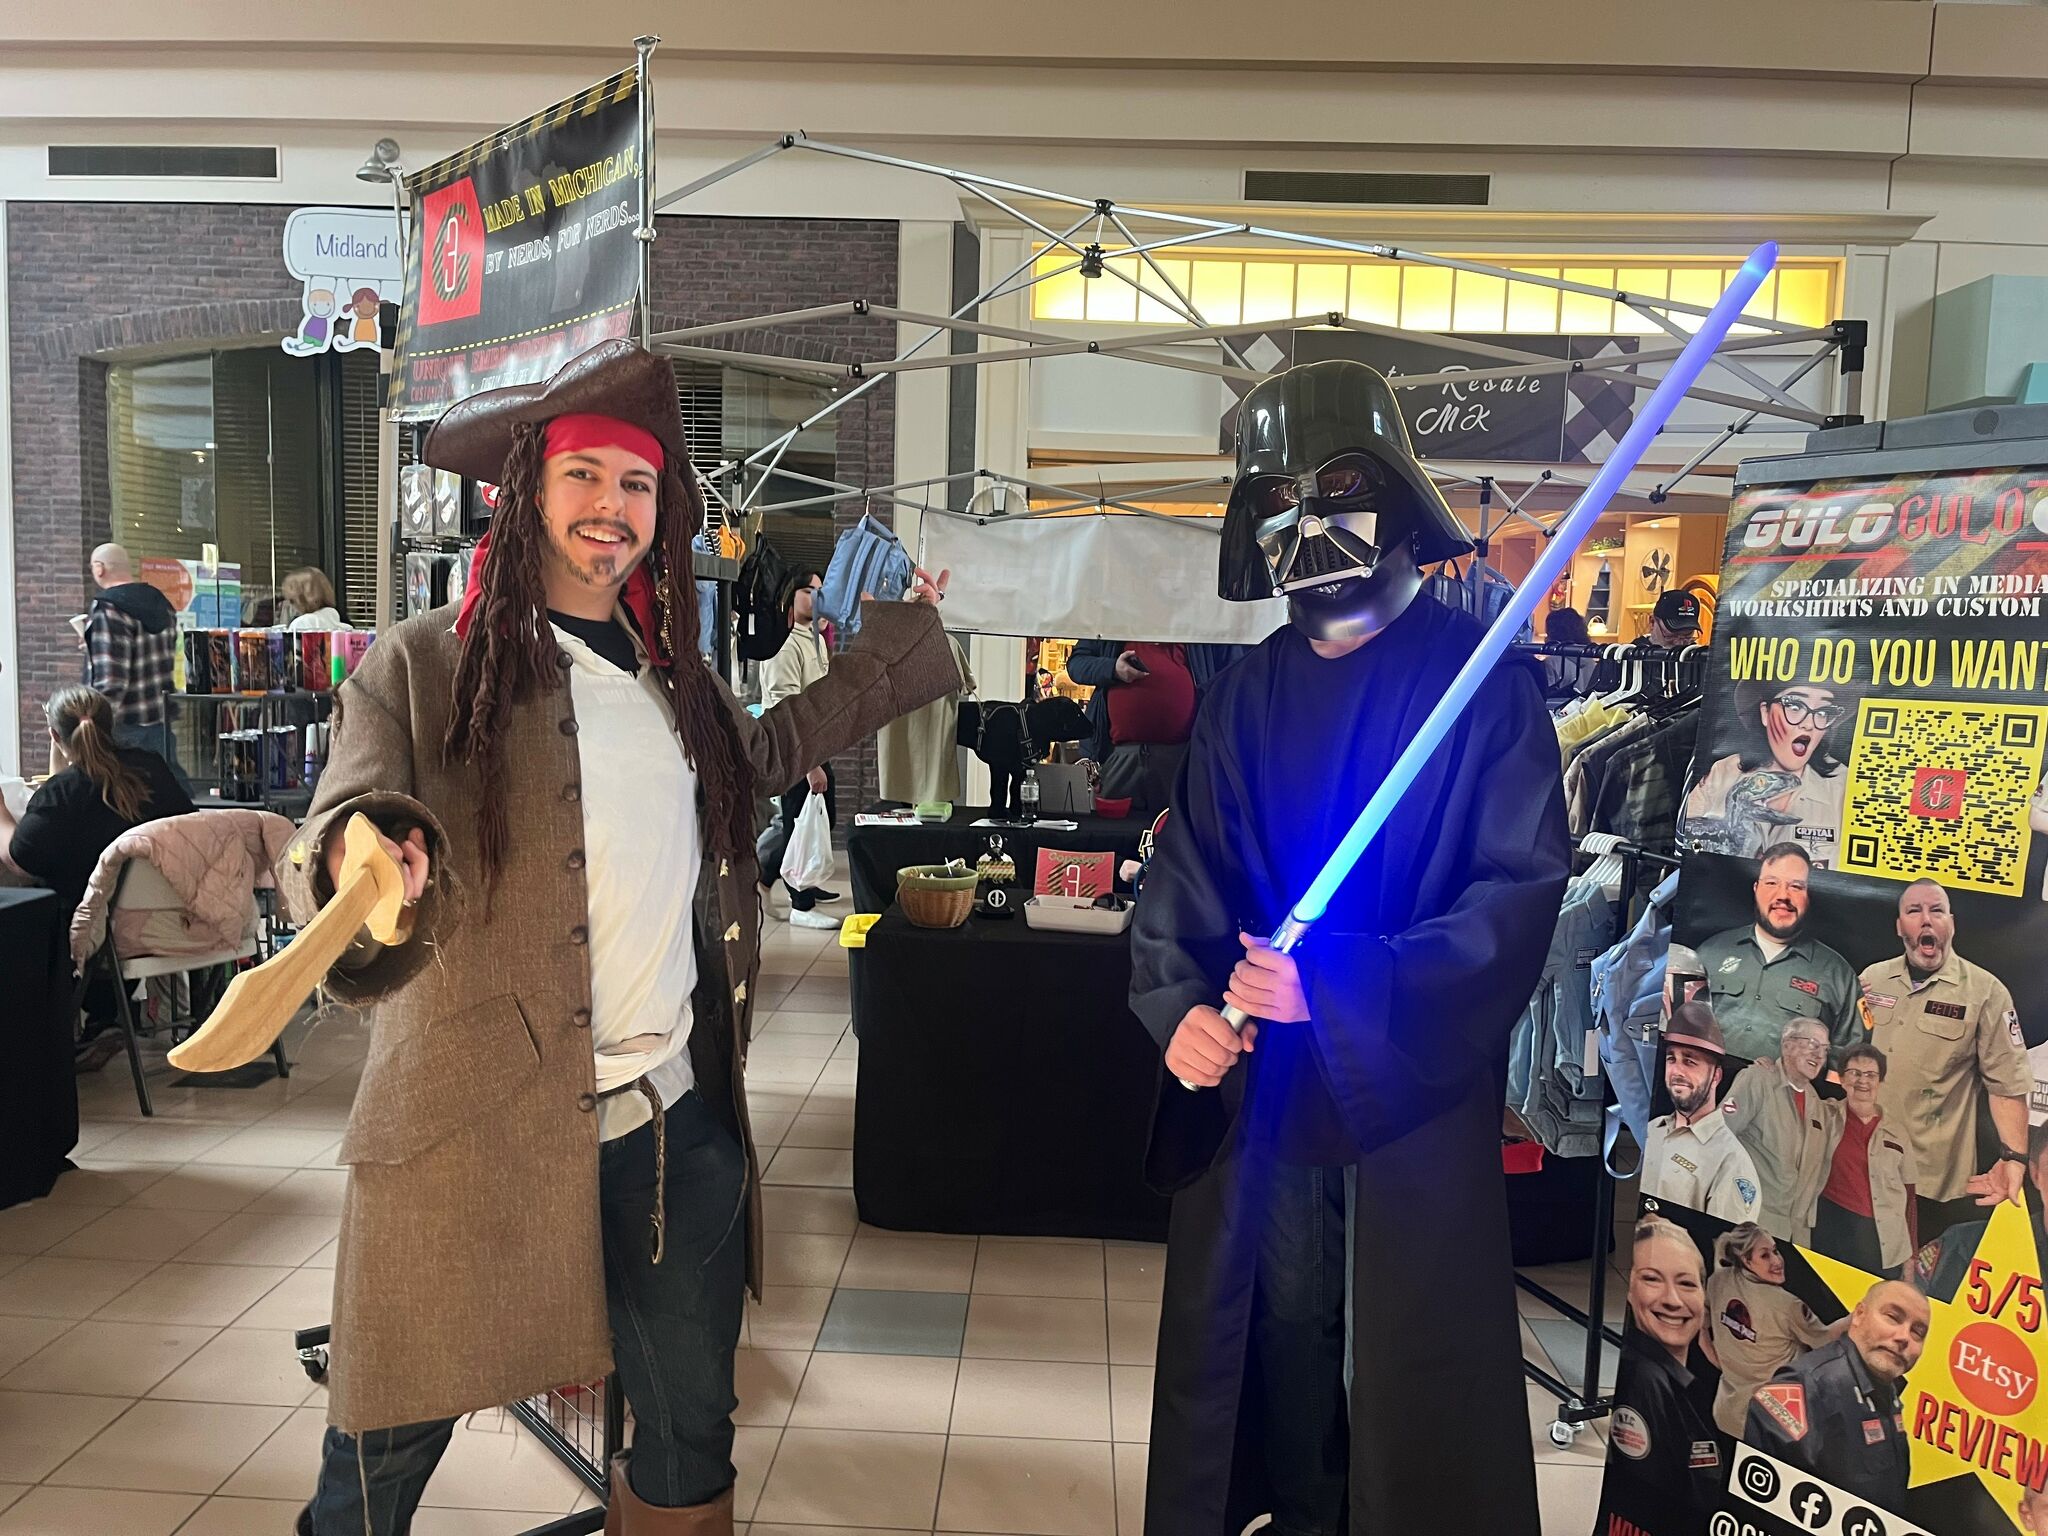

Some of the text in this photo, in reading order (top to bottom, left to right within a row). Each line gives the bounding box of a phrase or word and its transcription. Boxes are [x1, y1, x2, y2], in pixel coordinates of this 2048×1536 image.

[483, 145, 638, 233] MADE IN MICHIGAN,
[316, 233, 388, 258] Midland
[485, 201, 640, 275] BY NERDS, FOR NERDS...
[1439, 365, 1541, 402] Resale
[1897, 487, 2025, 544] GULO
[1729, 597, 2041, 618] WORKSHIRTS AND CUSTOM
[1770, 576, 1925, 598] SPECIALIZING
[1932, 575, 1960, 596] IN
[1729, 637, 1800, 682] WHO
[1808, 637, 1856, 684] DO
[1869, 638, 1937, 688] YOU
[1966, 1258, 2043, 1332] 5/5
[1953, 1339, 2035, 1399] Etsy
[1913, 1390, 2048, 1494] REVIEW
